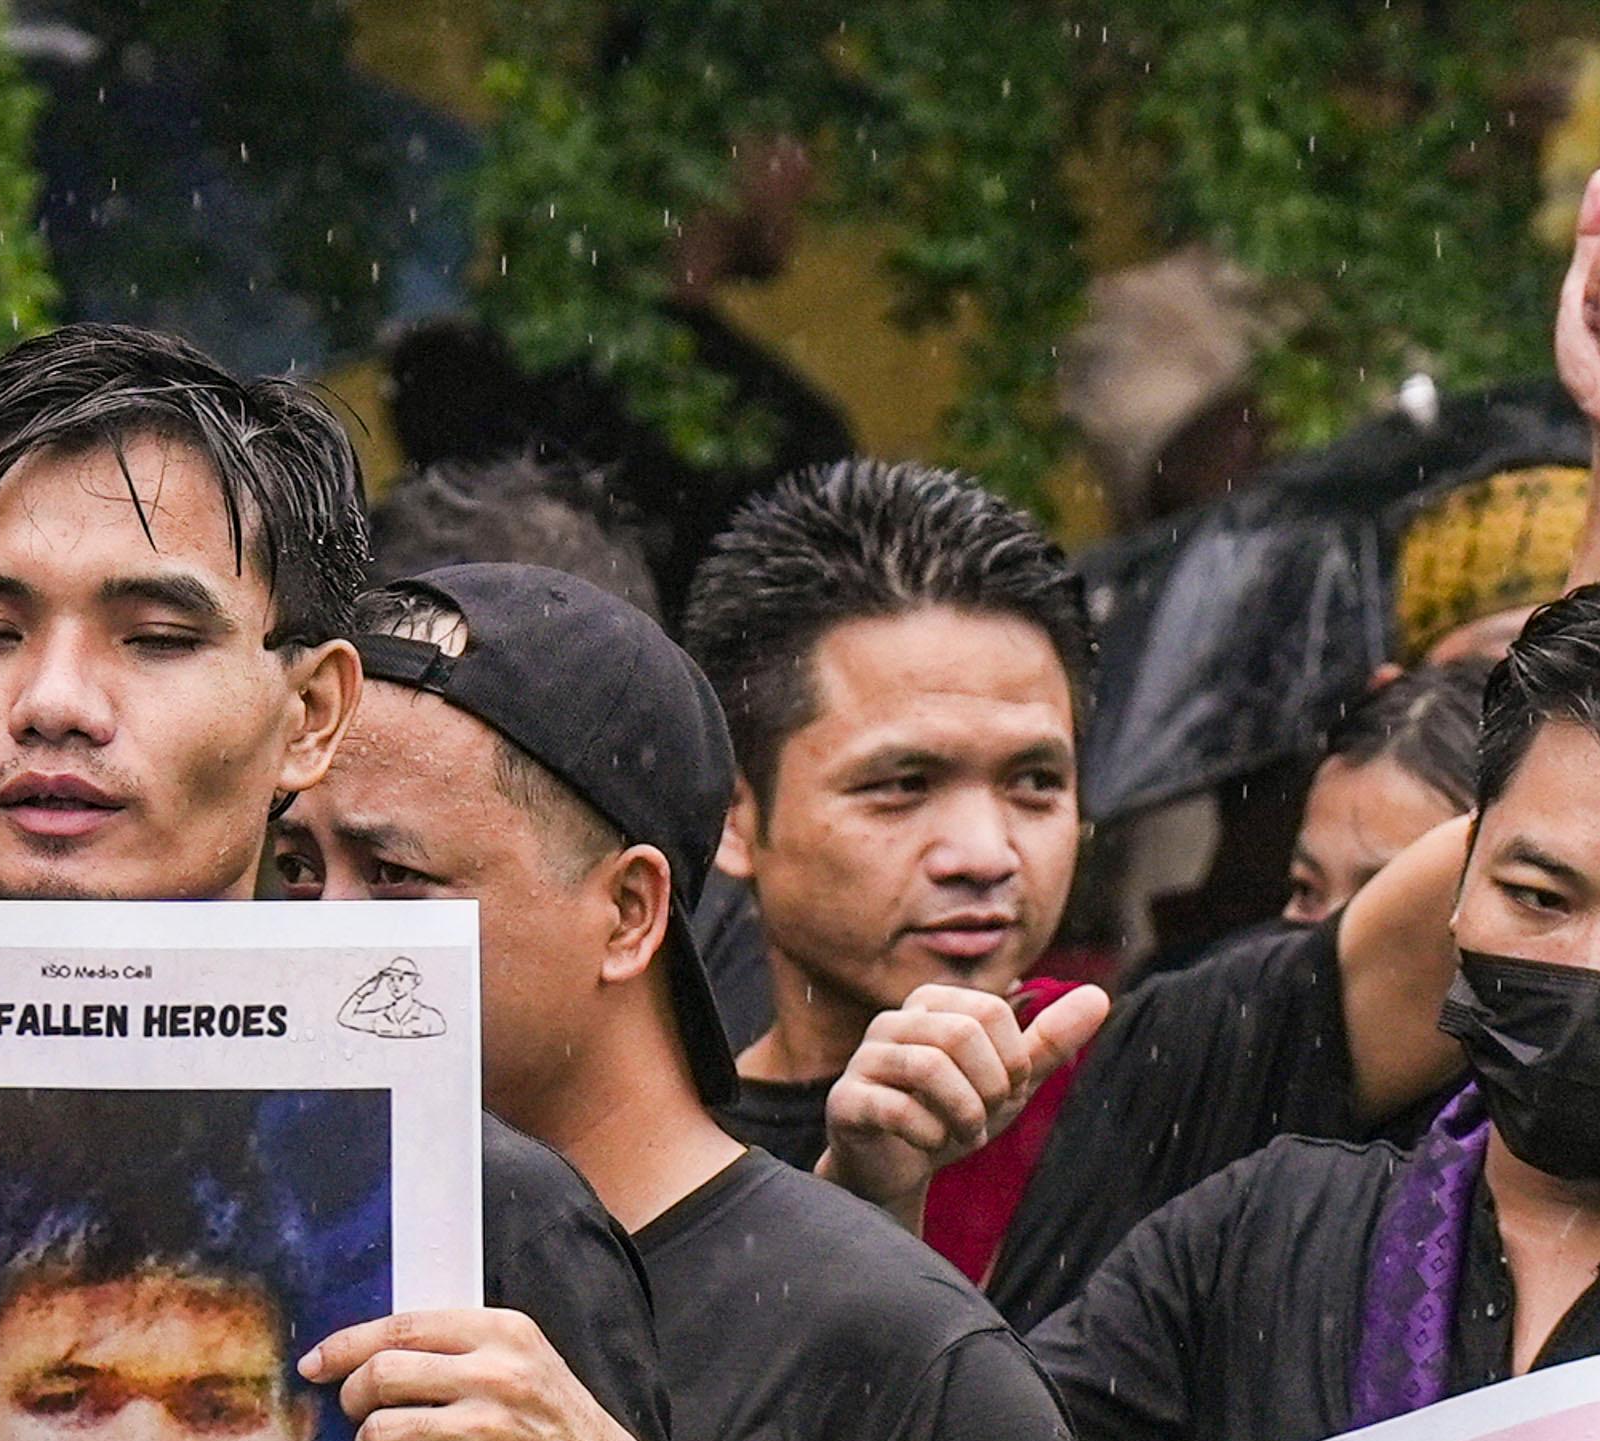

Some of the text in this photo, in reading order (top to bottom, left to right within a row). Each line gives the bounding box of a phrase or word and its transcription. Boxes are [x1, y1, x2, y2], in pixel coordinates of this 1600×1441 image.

[41, 965, 152, 979] KSO Media Cell
[143, 1004, 288, 1038] HEROES
